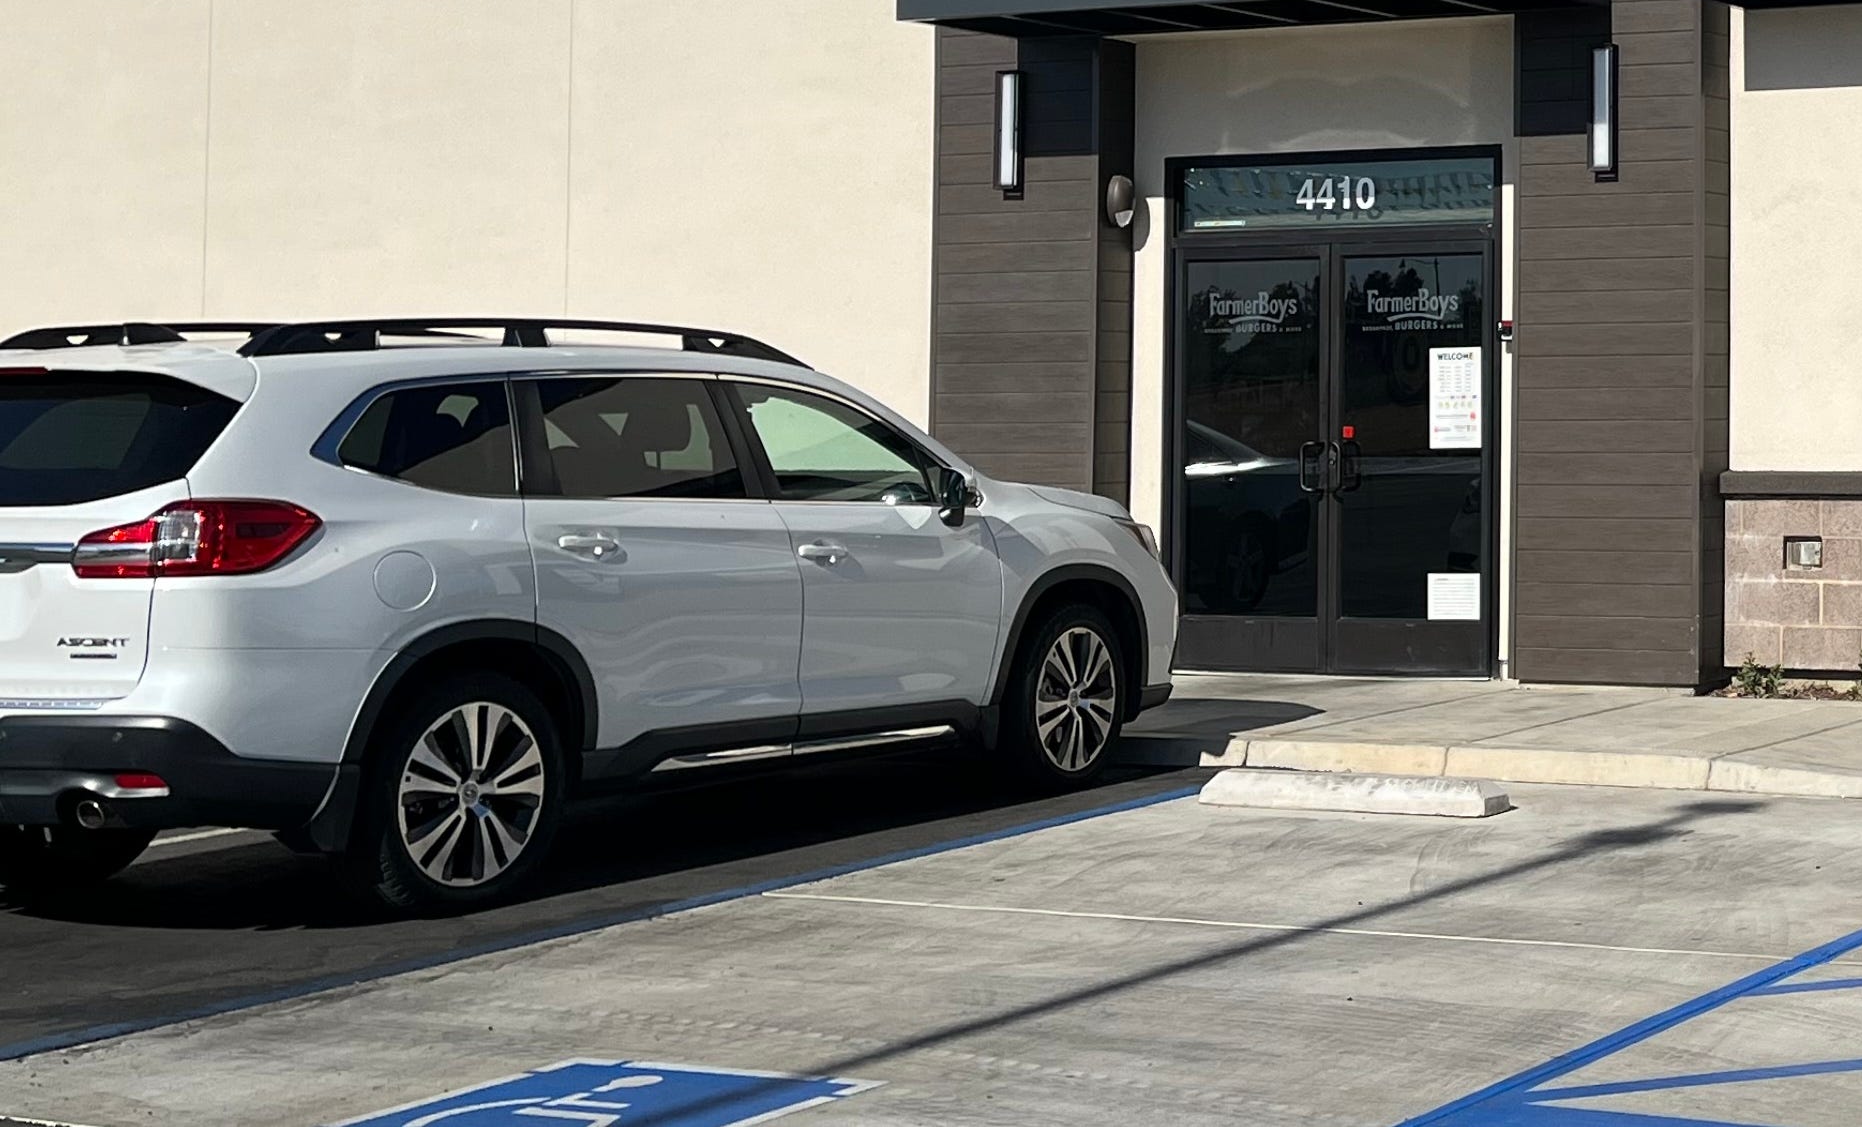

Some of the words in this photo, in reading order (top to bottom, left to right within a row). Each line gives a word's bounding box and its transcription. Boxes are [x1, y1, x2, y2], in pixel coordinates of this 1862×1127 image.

[1295, 175, 1376, 211] 4410
[1235, 323, 1278, 333] BURGERS
[1394, 320, 1438, 331] BURGERS
[1437, 352, 1474, 361] WELCOME
